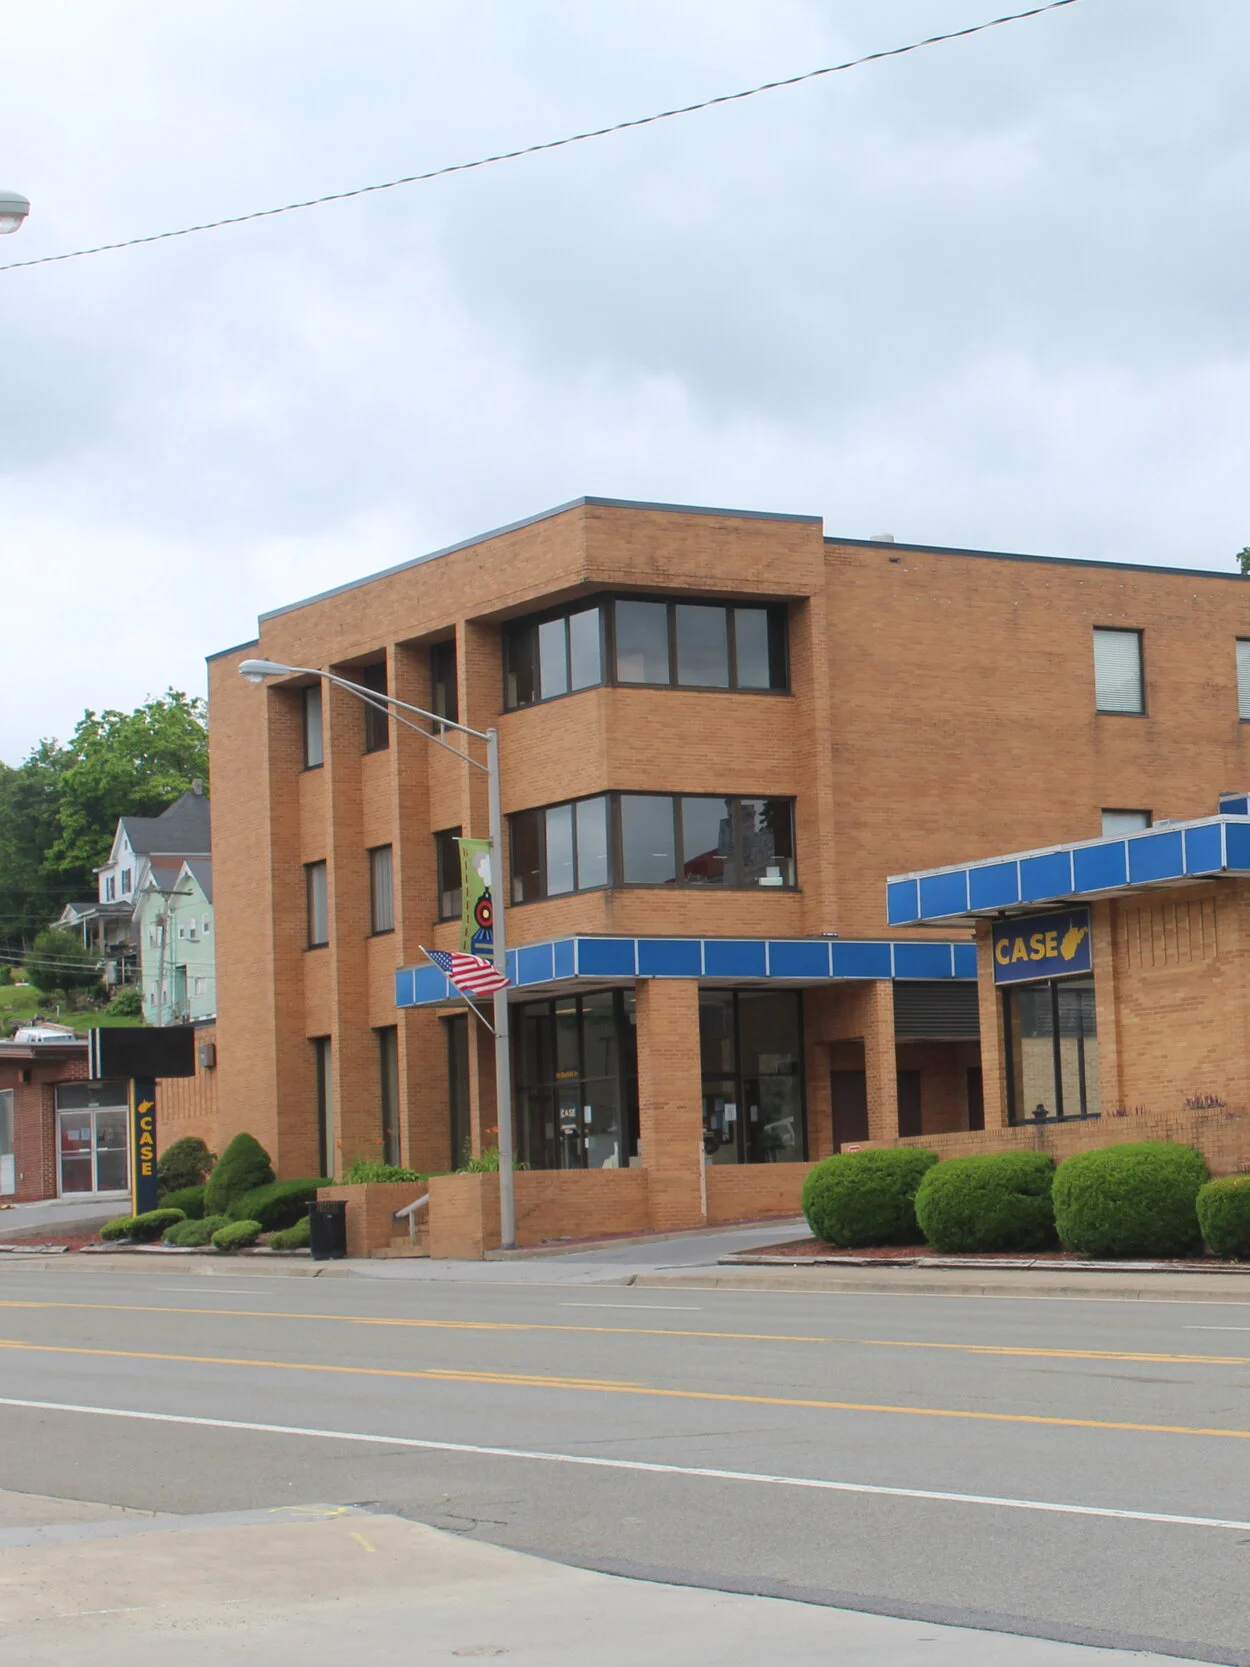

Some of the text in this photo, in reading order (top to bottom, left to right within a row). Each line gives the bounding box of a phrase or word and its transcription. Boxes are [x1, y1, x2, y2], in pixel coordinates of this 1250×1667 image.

[995, 931, 1058, 965] CASE
[560, 1107, 577, 1118] CASE
[140, 1117, 153, 1176] CASE
